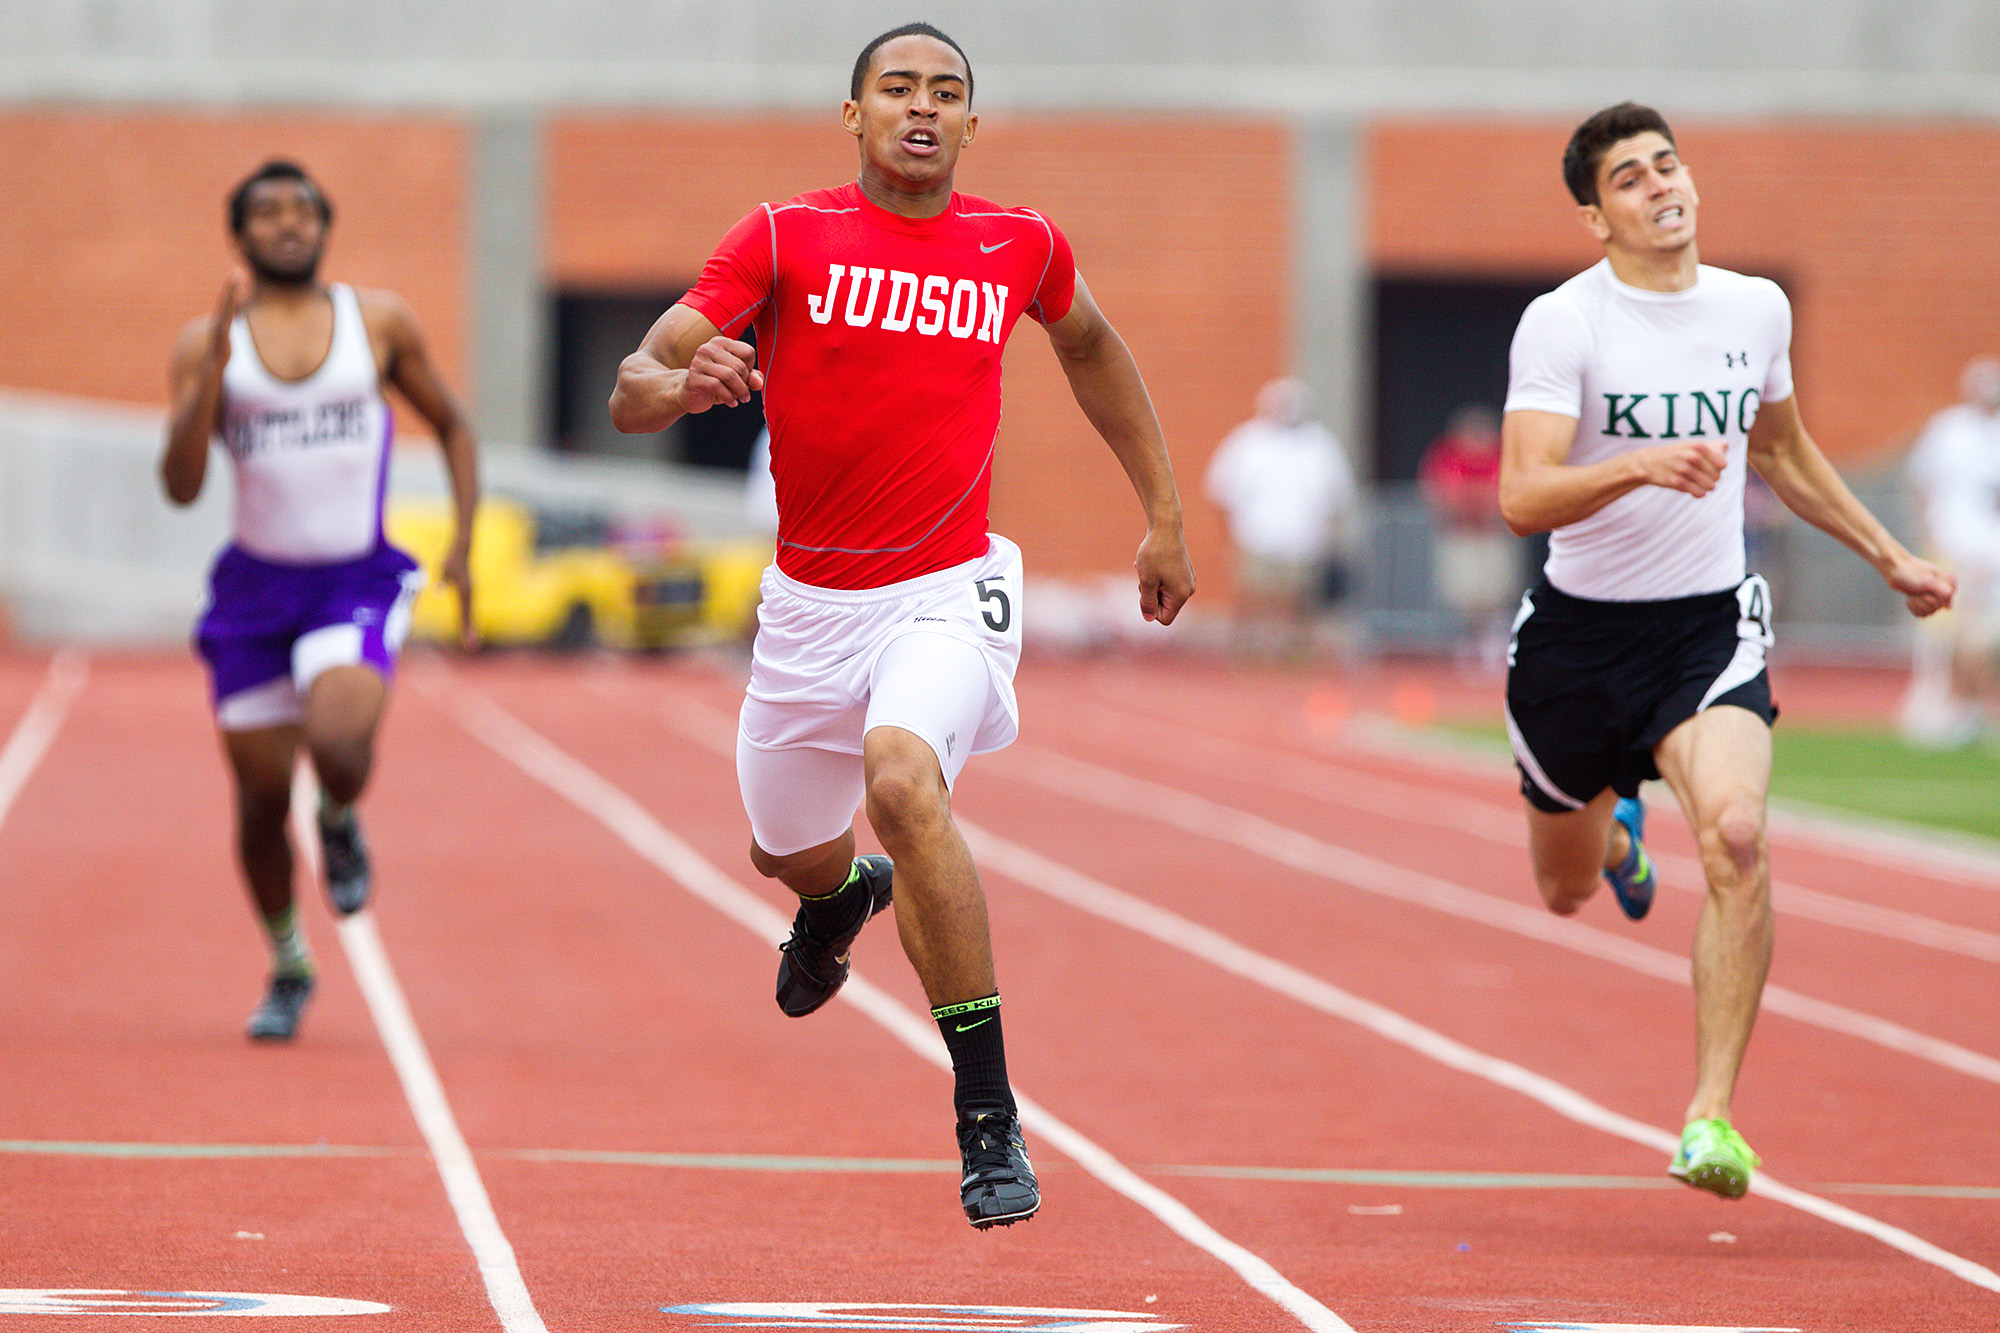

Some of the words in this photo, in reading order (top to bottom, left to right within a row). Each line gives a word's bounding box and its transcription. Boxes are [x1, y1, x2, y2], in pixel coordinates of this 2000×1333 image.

[808, 263, 1009, 345] JUDSON
[975, 575, 1011, 633] 5
[1748, 583, 1767, 637] 4
